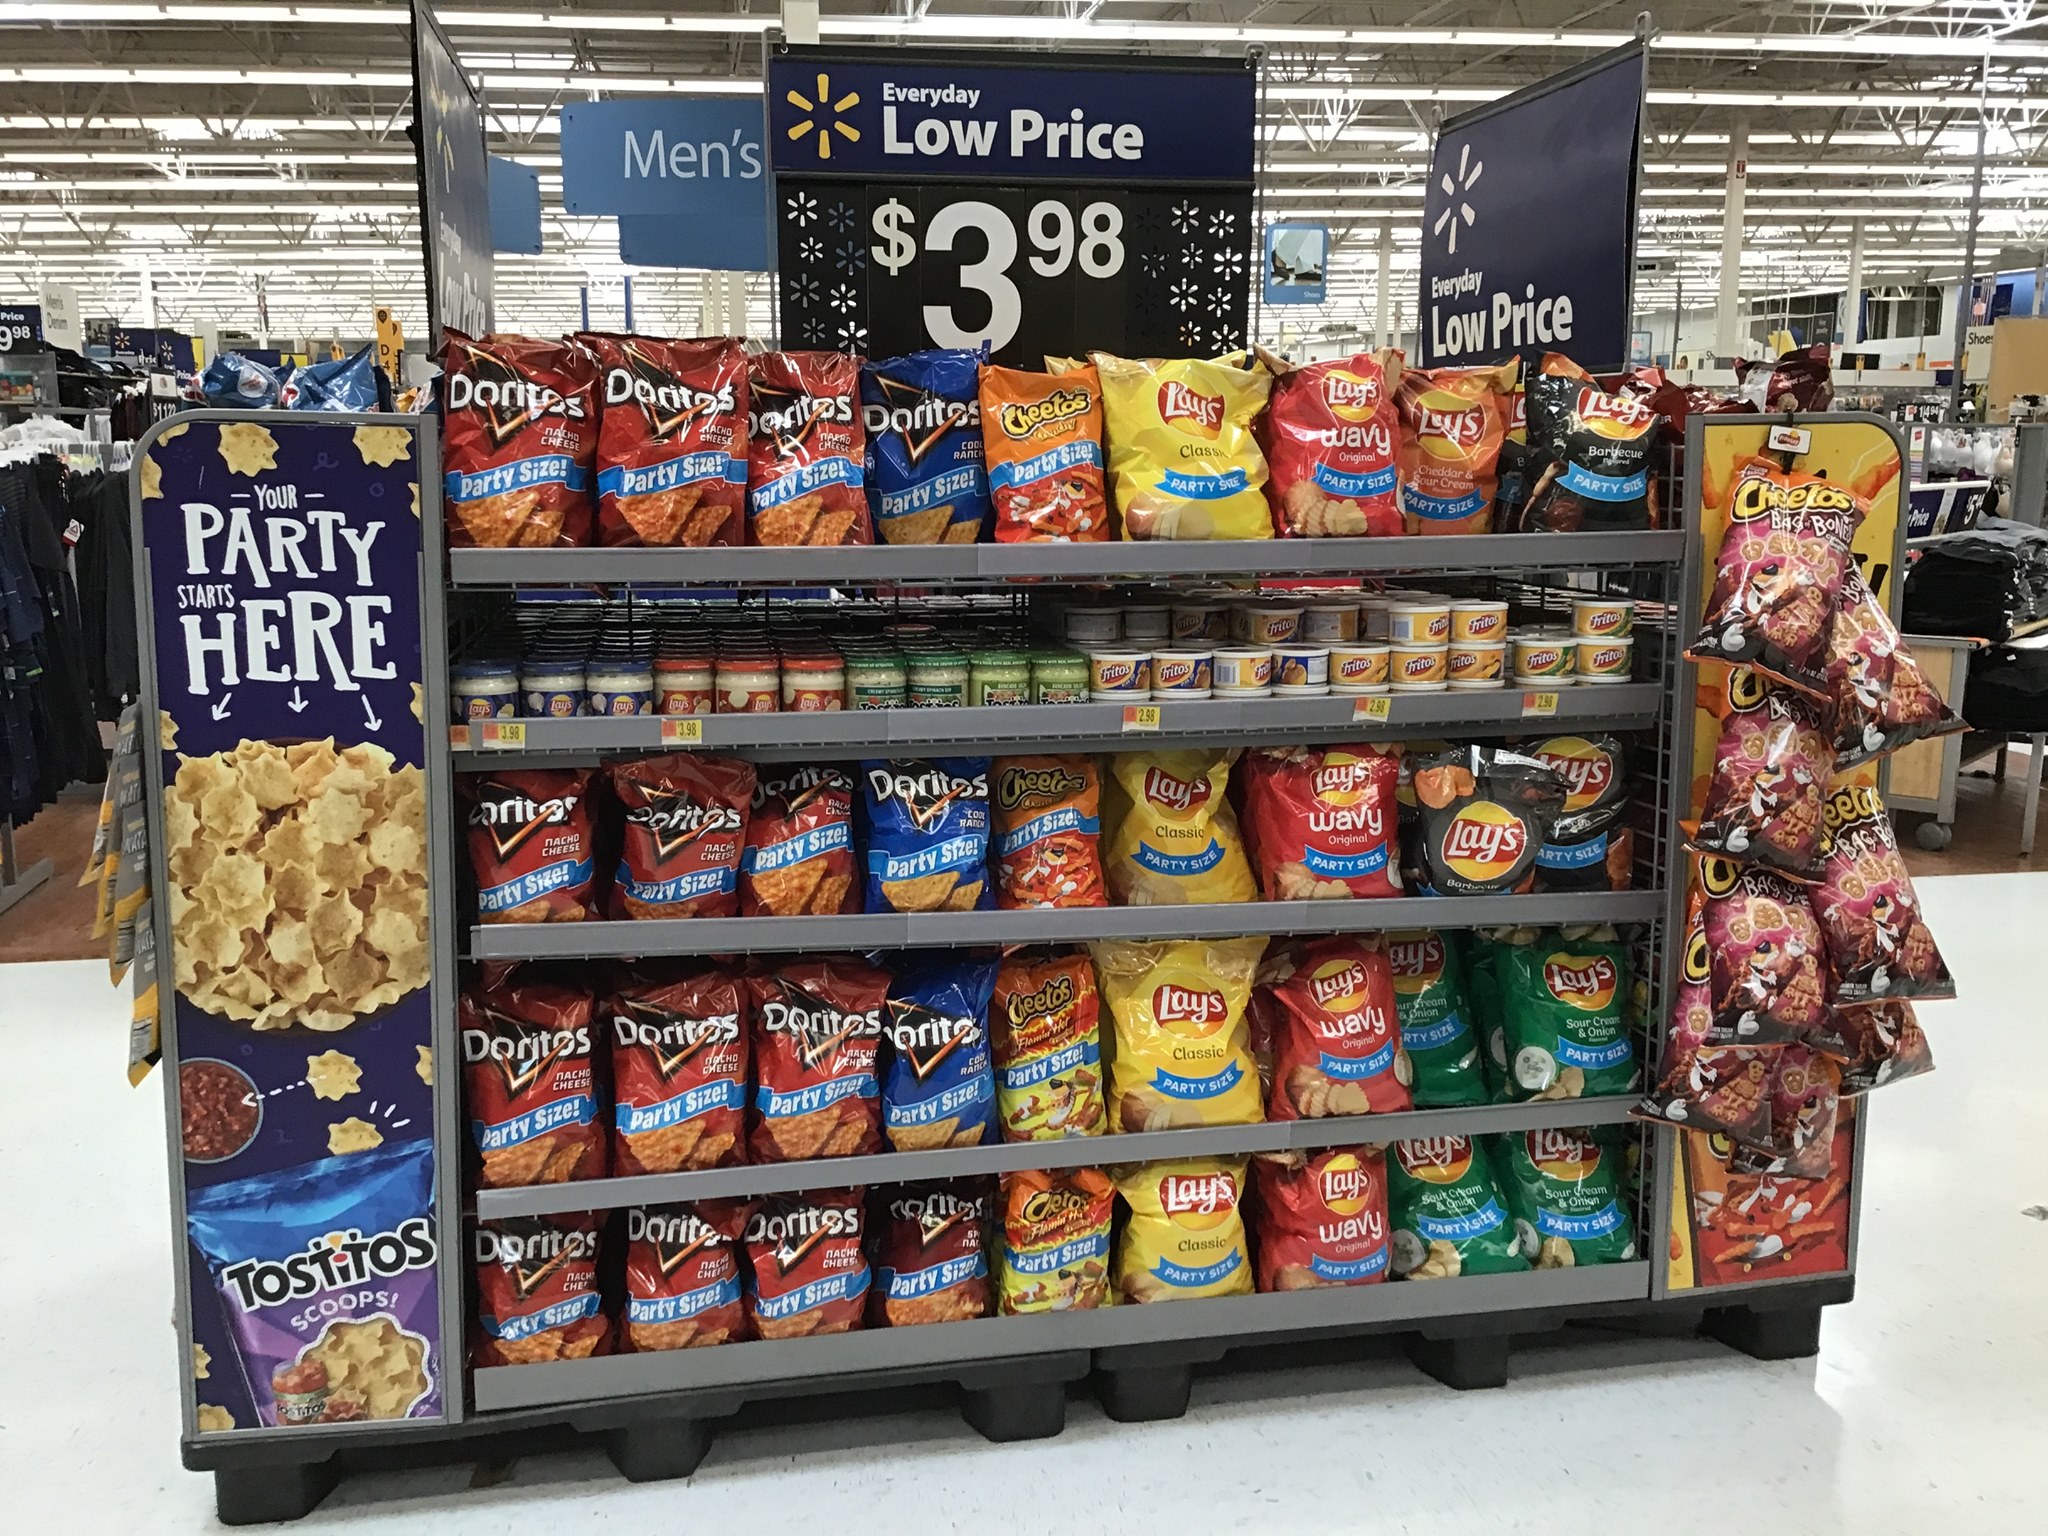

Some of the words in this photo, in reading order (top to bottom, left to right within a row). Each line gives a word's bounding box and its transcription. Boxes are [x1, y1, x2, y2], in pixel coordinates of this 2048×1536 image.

[882, 83, 980, 108] Everyday
[883, 106, 997, 157] Low
[1010, 108, 1144, 159] Price
[624, 127, 761, 179] Men's
[1432, 268, 1483, 300] Everyday
[1, 311, 24, 321] Price
[1432, 305, 1487, 357] Low
[1493, 283, 1573, 350] Price
[450, 374, 584, 419] Doritos
[606, 369, 736, 415] Doritos
[1165, 381, 1221, 425] Lay's
[1001, 390, 1090, 440] Cheetos
[541, 437, 580, 451] CHEESE
[545, 427, 579, 441] NACHO
[1321, 423, 1390, 456] wavy
[961, 441, 984, 450] COOL
[1588, 445, 1643, 460] Barbecue
[1339, 451, 1376, 464] Original
[461, 464, 515, 498] Party
[519, 457, 568, 482] Size!
[623, 465, 677, 493] Party
[682, 454, 724, 477] Size!
[1323, 473, 1366, 489] PARTY
[1368, 472, 1394, 488] SIZE
[1418, 465, 1462, 480] Cheddar
[752, 476, 797, 510] Party
[802, 463, 845, 488] Size!
[882, 482, 936, 516] Party
[941, 470, 976, 496] Size!
[1439, 477, 1474, 490] Cream
[254, 484, 298, 511] YOUR
[1732, 477, 1855, 521] Cheetos
[180, 503, 386, 588] PARTY
[177, 584, 235, 609] STARTS
[1268, 618, 1296, 634] Fritos
[1469, 615, 1499, 632] Fritos
[1591, 613, 1620, 629] Fritos
[179, 591, 398, 695] HERE
[1341, 658, 1372, 675] Fritos
[1406, 656, 1436, 674] Fritos
[1528, 652, 1558, 668] Fritos
[1595, 650, 1623, 666] Fritos
[1101, 664, 1131, 681] Fritos
[1160, 664, 1190, 680] Fritos
[468, 703, 491, 716] Lay's
[551, 700, 572, 713] Lay's
[612, 701, 634, 713] Lay's
[668, 698, 689, 710] Lay's
[800, 698, 821, 709] Lay's
[1369, 700, 1385, 713] 2.98
[1138, 708, 1155, 722] 2.98
[501, 726, 520, 740] 3.98
[679, 722, 697, 736] 3.98
[869, 769, 988, 801] Doritos
[1001, 767, 1087, 809] Cheetos
[960, 818, 985, 828] RANCH
[967, 810, 986, 819] COOL
[1309, 807, 1383, 836] wavy
[545, 833, 579, 847] NACHO
[1155, 825, 1204, 839] Classic
[1328, 833, 1368, 846] Original
[1447, 820, 1520, 863] Lay's
[542, 843, 580, 856] CHEESE
[756, 841, 804, 870] Party
[808, 826, 848, 850] Size!
[887, 851, 936, 878] Party
[941, 838, 978, 862] Size!
[1145, 852, 1187, 870] PARTY
[1191, 850, 1217, 869] SIZE
[1312, 856, 1354, 871] PARTY
[1356, 852, 1384, 869] SIZE
[1316, 965, 1366, 1003] Lay's
[1552, 960, 1612, 997] Lay's
[1008, 977, 1074, 1027] Cheetos
[1159, 986, 1224, 1023] Lay's
[613, 1013, 738, 1046] Doritos
[763, 1003, 881, 1037] Doritos
[1320, 1006, 1386, 1038] wavy
[1566, 1018, 1590, 1029] Sour
[1591, 1016, 1620, 1028] Cream
[1342, 1034, 1375, 1050] Original
[1578, 1028, 1586, 1038] &
[1587, 1026, 1616, 1037] Onion
[463, 1027, 591, 1062] Doritos
[1173, 1045, 1224, 1060] Classic
[702, 1062, 738, 1074] CHEESE
[1327, 1060, 1366, 1075] PARTY
[1368, 1052, 1391, 1070] SIZE
[553, 1078, 591, 1091] CHEESE
[556, 1068, 591, 1081] NACHO
[1163, 1079, 1206, 1094] PARTY
[1209, 1071, 1235, 1091] SIZE
[630, 1102, 680, 1131] Party
[686, 1083, 728, 1111] Size!
[891, 1099, 937, 1125] Party
[942, 1081, 980, 1109] Size!
[481, 1118, 529, 1149] Party
[534, 1099, 580, 1127] Size!
[1167, 1173, 1236, 1215] Lay's
[1326, 1168, 1368, 1200] Lay's
[1451, 1184, 1483, 1199] Cream
[1545, 1188, 1569, 1200] Sour
[1571, 1186, 1608, 1198] Cream
[1447, 1196, 1477, 1208] Onion
[1558, 1198, 1567, 1208] &
[1569, 1196, 1600, 1206] Onion
[1319, 1210, 1382, 1243] wavy
[1017, 1249, 1058, 1271] Party
[1061, 1236, 1096, 1263] Size!
[1178, 1236, 1227, 1252] Classic
[1335, 1239, 1371, 1254] Original
[1164, 1267, 1206, 1282] PARTY
[1209, 1259, 1235, 1278] SIZE
[1318, 1262, 1357, 1276] PARTY
[1360, 1254, 1384, 1272] SIZE
[805, 1274, 847, 1300] Size!
[291, 1291, 399, 1332] SCOOPS!
[630, 1300, 675, 1321] Party
[679, 1285, 721, 1314] Size!
